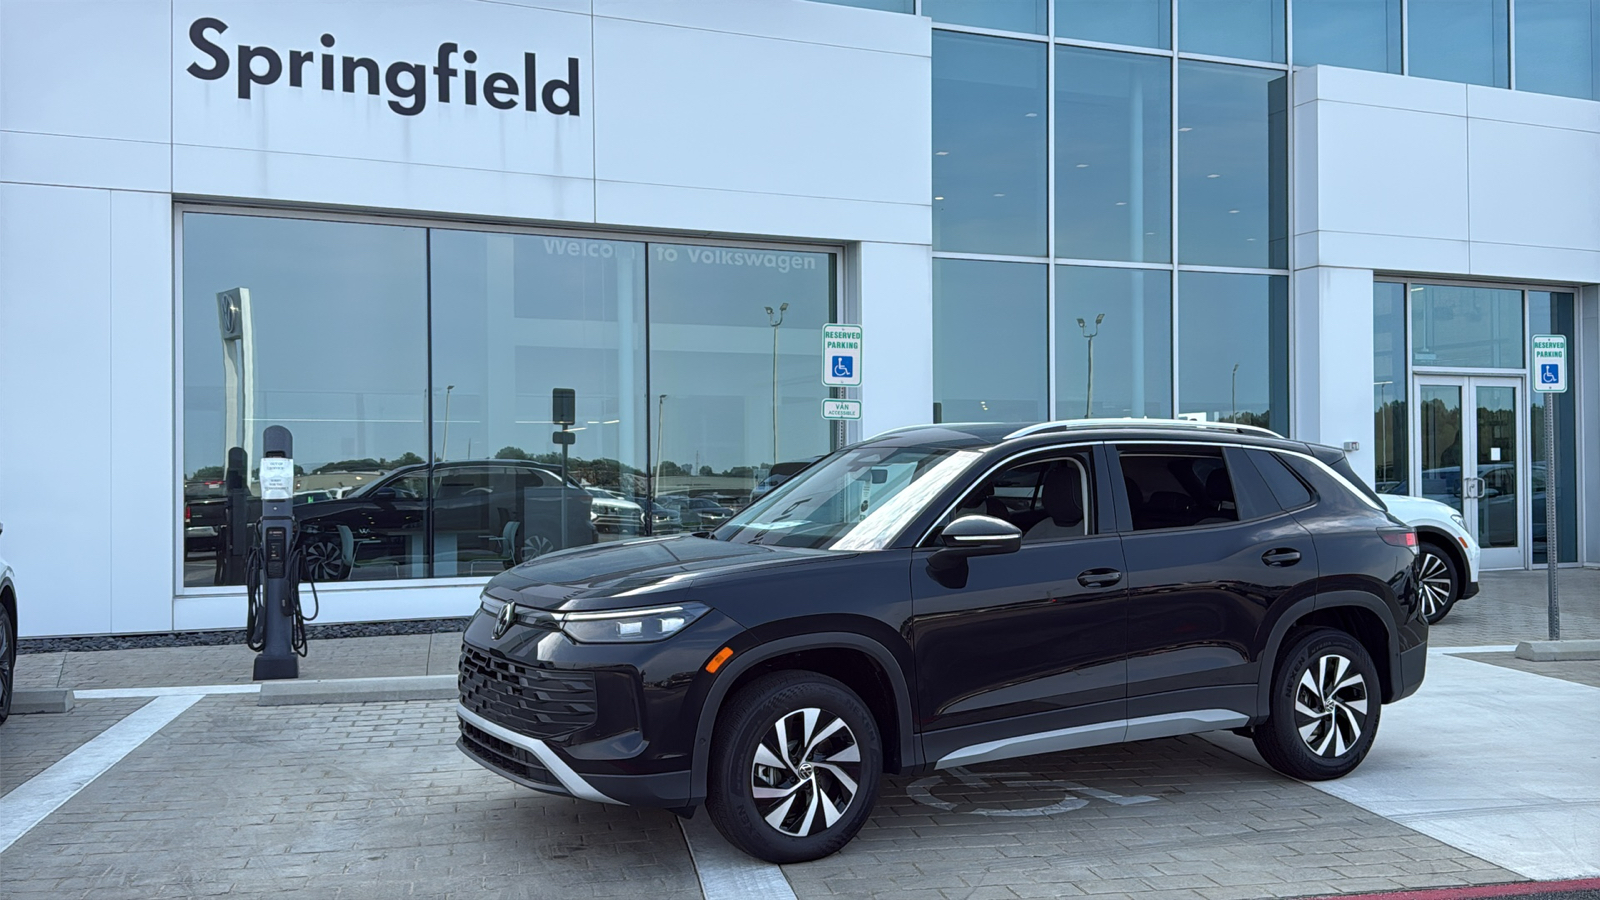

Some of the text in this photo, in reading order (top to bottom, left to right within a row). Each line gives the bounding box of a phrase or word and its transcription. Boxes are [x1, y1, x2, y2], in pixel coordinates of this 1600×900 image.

[186, 17, 580, 116] Springfield
[656, 246, 678, 262] to
[687, 248, 816, 274] Volkswagen
[825, 331, 861, 339] RESERVED
[827, 341, 858, 349] PARKING
[1534, 341, 1564, 349] RESERVED
[1536, 350, 1562, 358] PARKING
[1285, 656, 1306, 698] NEXEN
